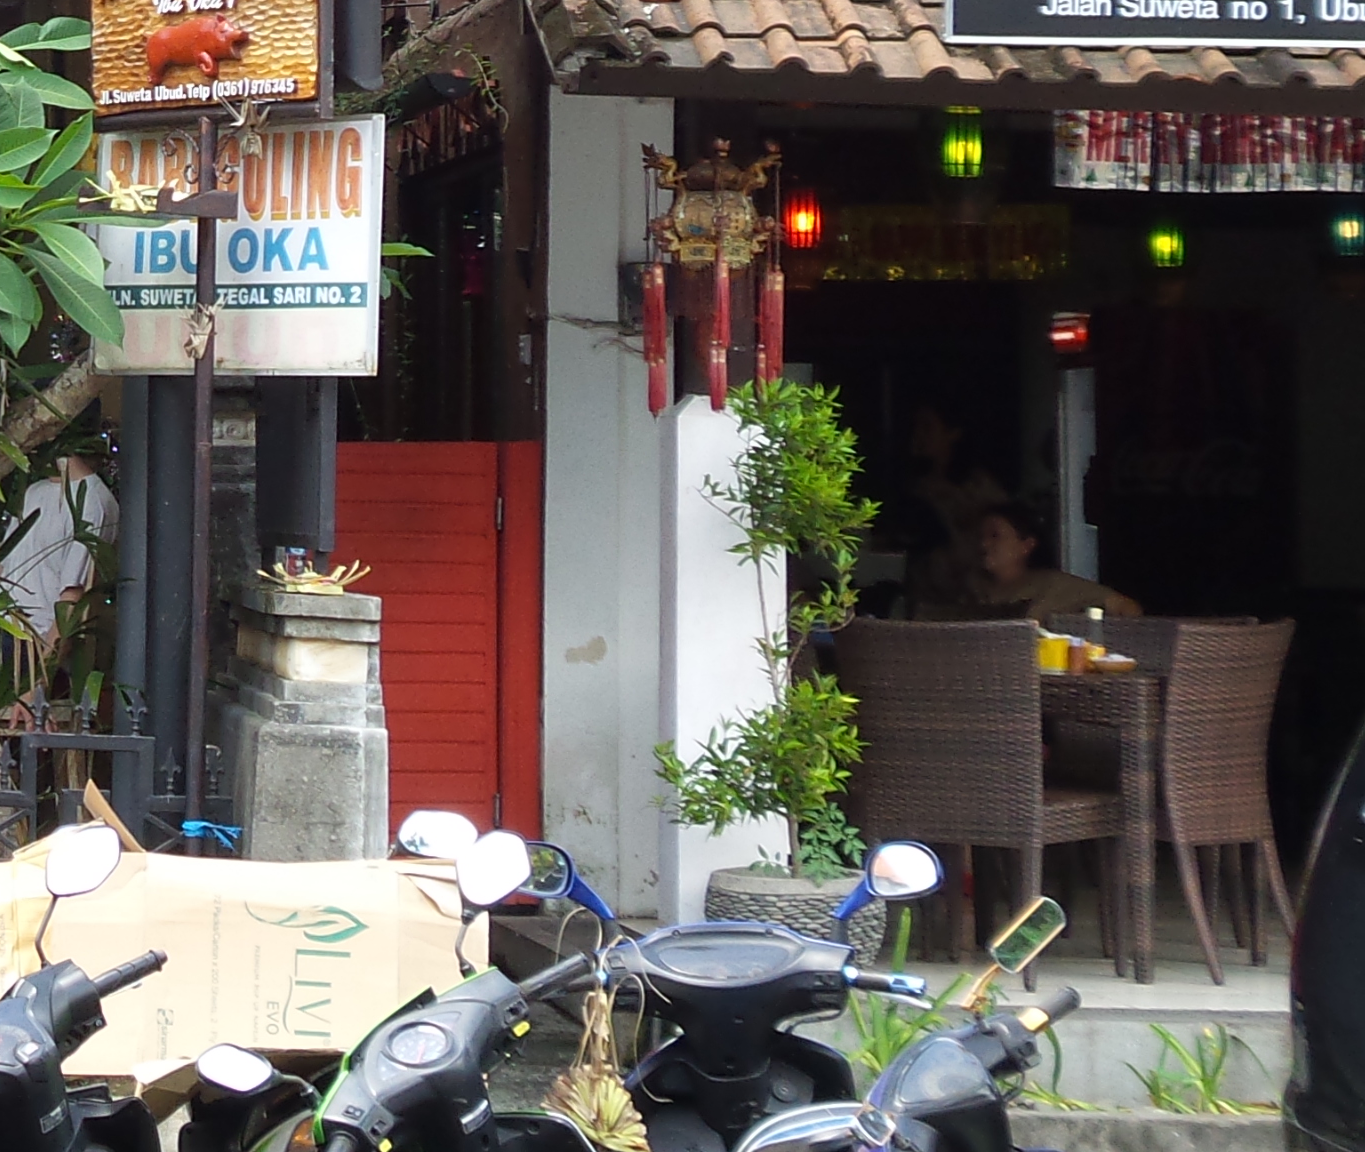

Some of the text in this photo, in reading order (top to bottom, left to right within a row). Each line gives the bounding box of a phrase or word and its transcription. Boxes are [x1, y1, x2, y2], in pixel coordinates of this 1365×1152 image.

[212, 79, 250, 98] (0361)
[250, 77, 295, 95] 976345
[228, 227, 330, 273] OKA
[216, 287, 269, 306] TEGAL
[273, 286, 312, 305] SARI
[315, 286, 346, 305] NO.
[349, 286, 362, 304] 2
[294, 949, 352, 1038] LIVI
[266, 1001, 280, 1036] EVO
